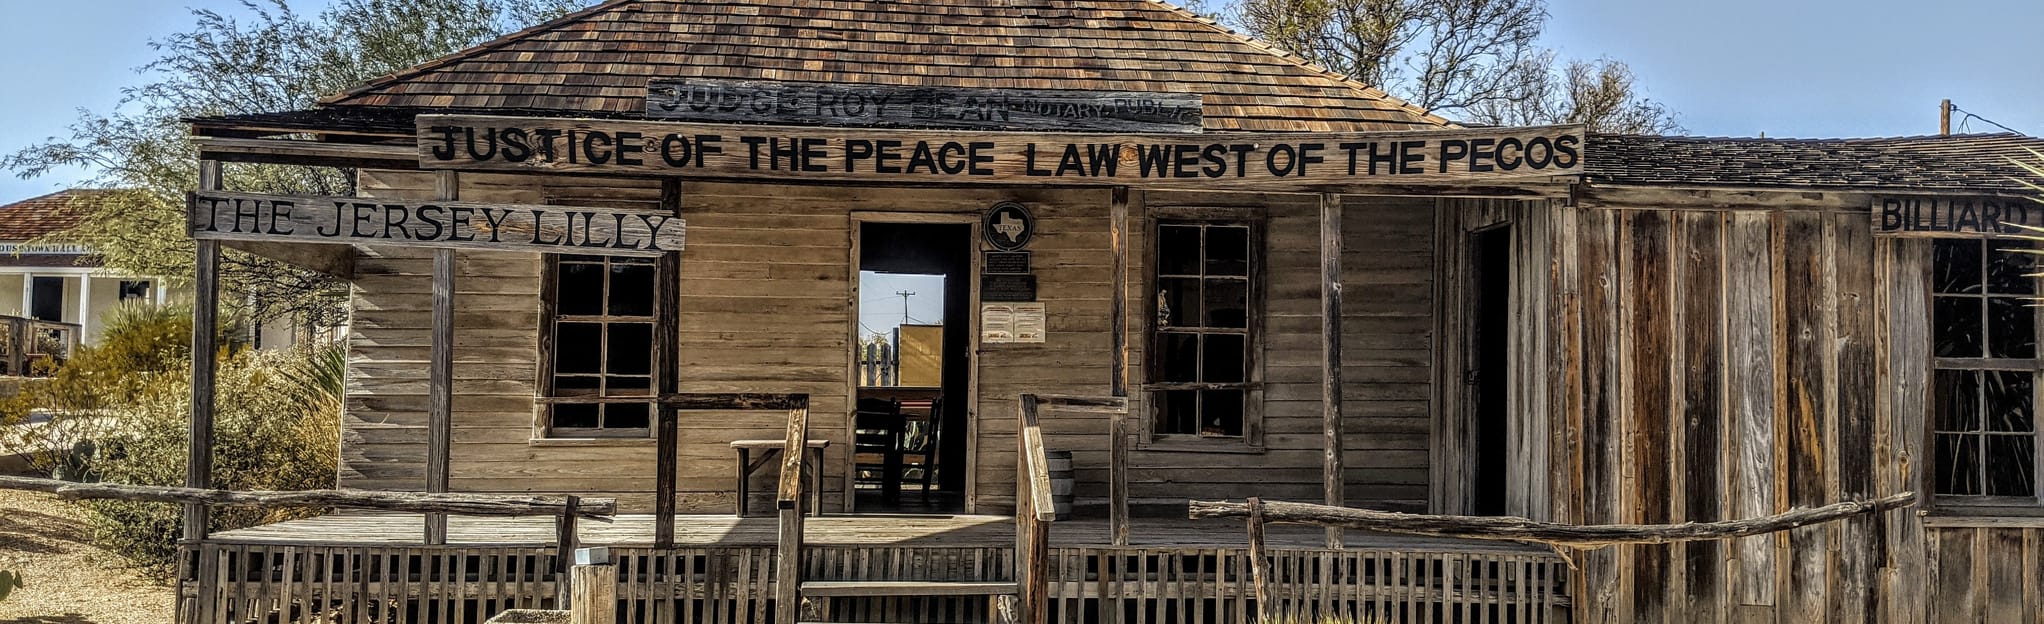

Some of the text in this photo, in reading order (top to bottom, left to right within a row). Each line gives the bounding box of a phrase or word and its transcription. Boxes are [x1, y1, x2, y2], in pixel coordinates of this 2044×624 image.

[815, 89, 895, 118] ROY
[910, 91, 1009, 122] BEAN
[431, 125, 1579, 178] JUSTICE OF THE PEACE LAW WEST OF THE PECOS
[199, 197, 676, 250] THE JERSEY LILLY
[1881, 198, 2028, 233] BILLIARD
[26, 244, 50, 252] TOWN
[52, 244, 77, 252] HALL
